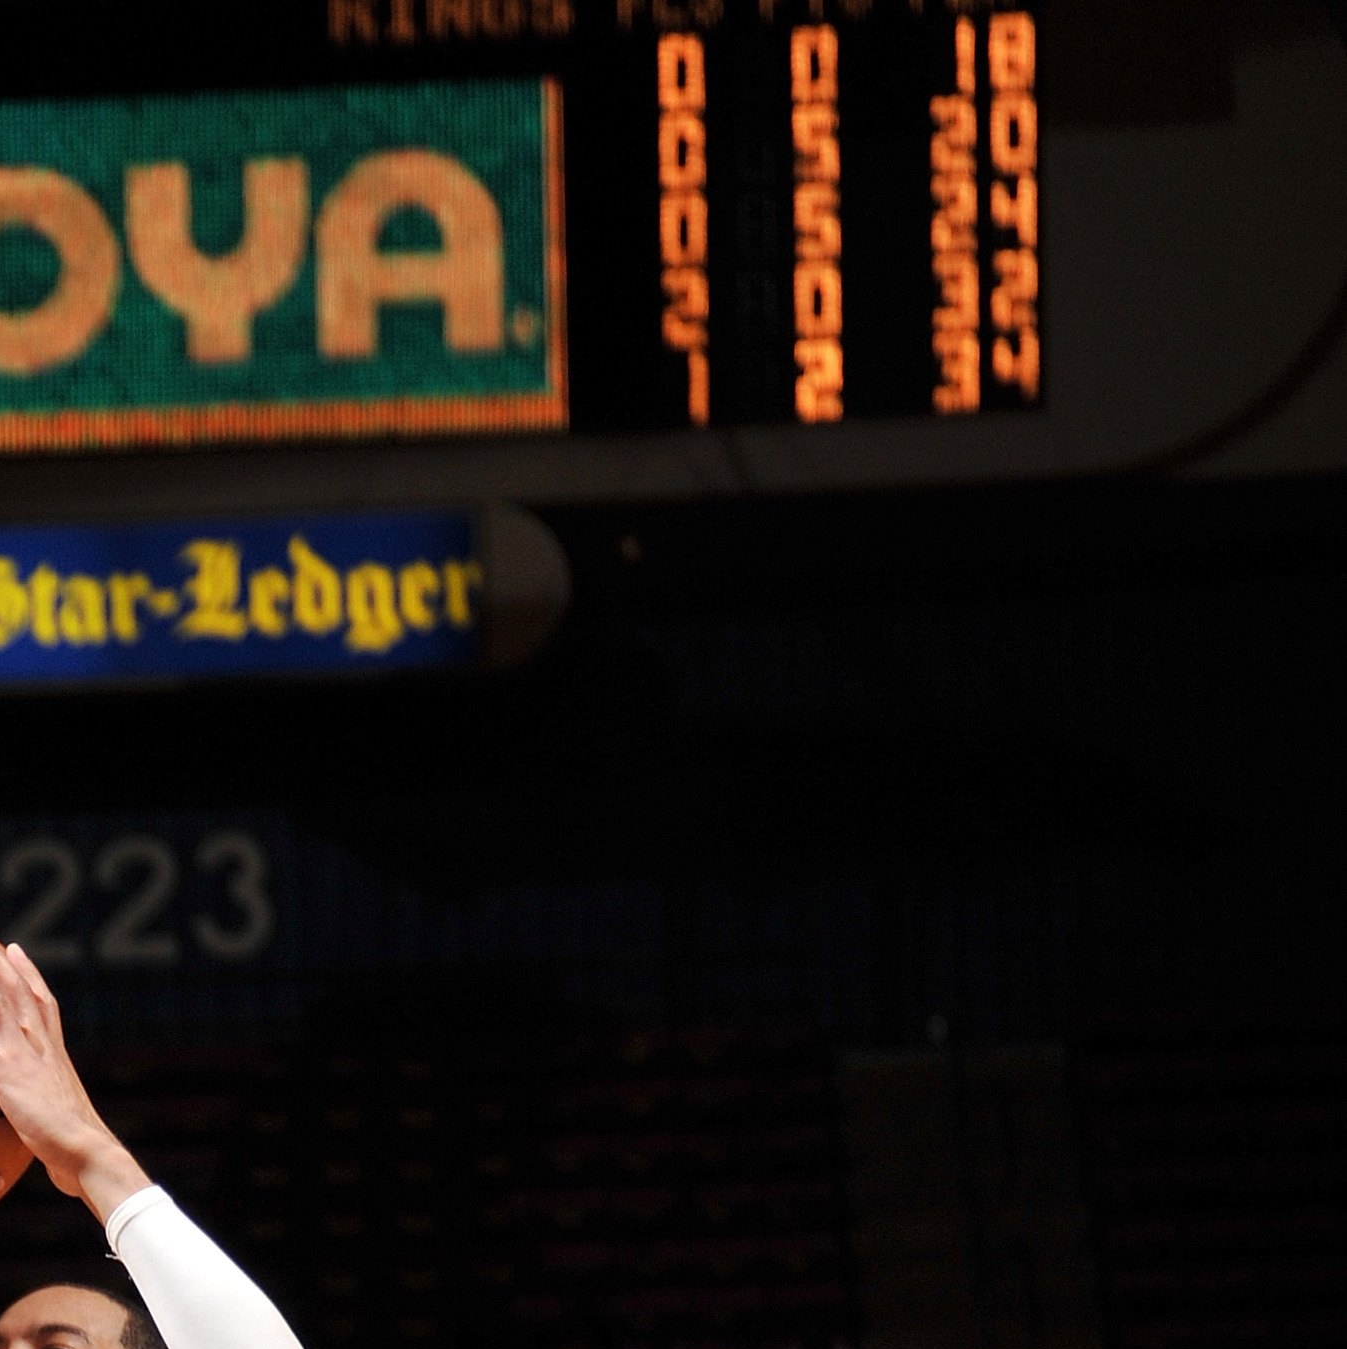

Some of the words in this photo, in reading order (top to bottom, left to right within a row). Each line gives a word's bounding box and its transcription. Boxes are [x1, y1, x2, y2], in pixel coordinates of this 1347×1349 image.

[658, 33, 705, 110] 0
[790, 24, 839, 101] 0
[956, 12, 1036, 94] 18
[660, 112, 706, 187] 0
[792, 102, 840, 181] 5
[660, 191, 708, 266] 0
[794, 261, 842, 337] 0
[688, 351, 710, 425] 1
